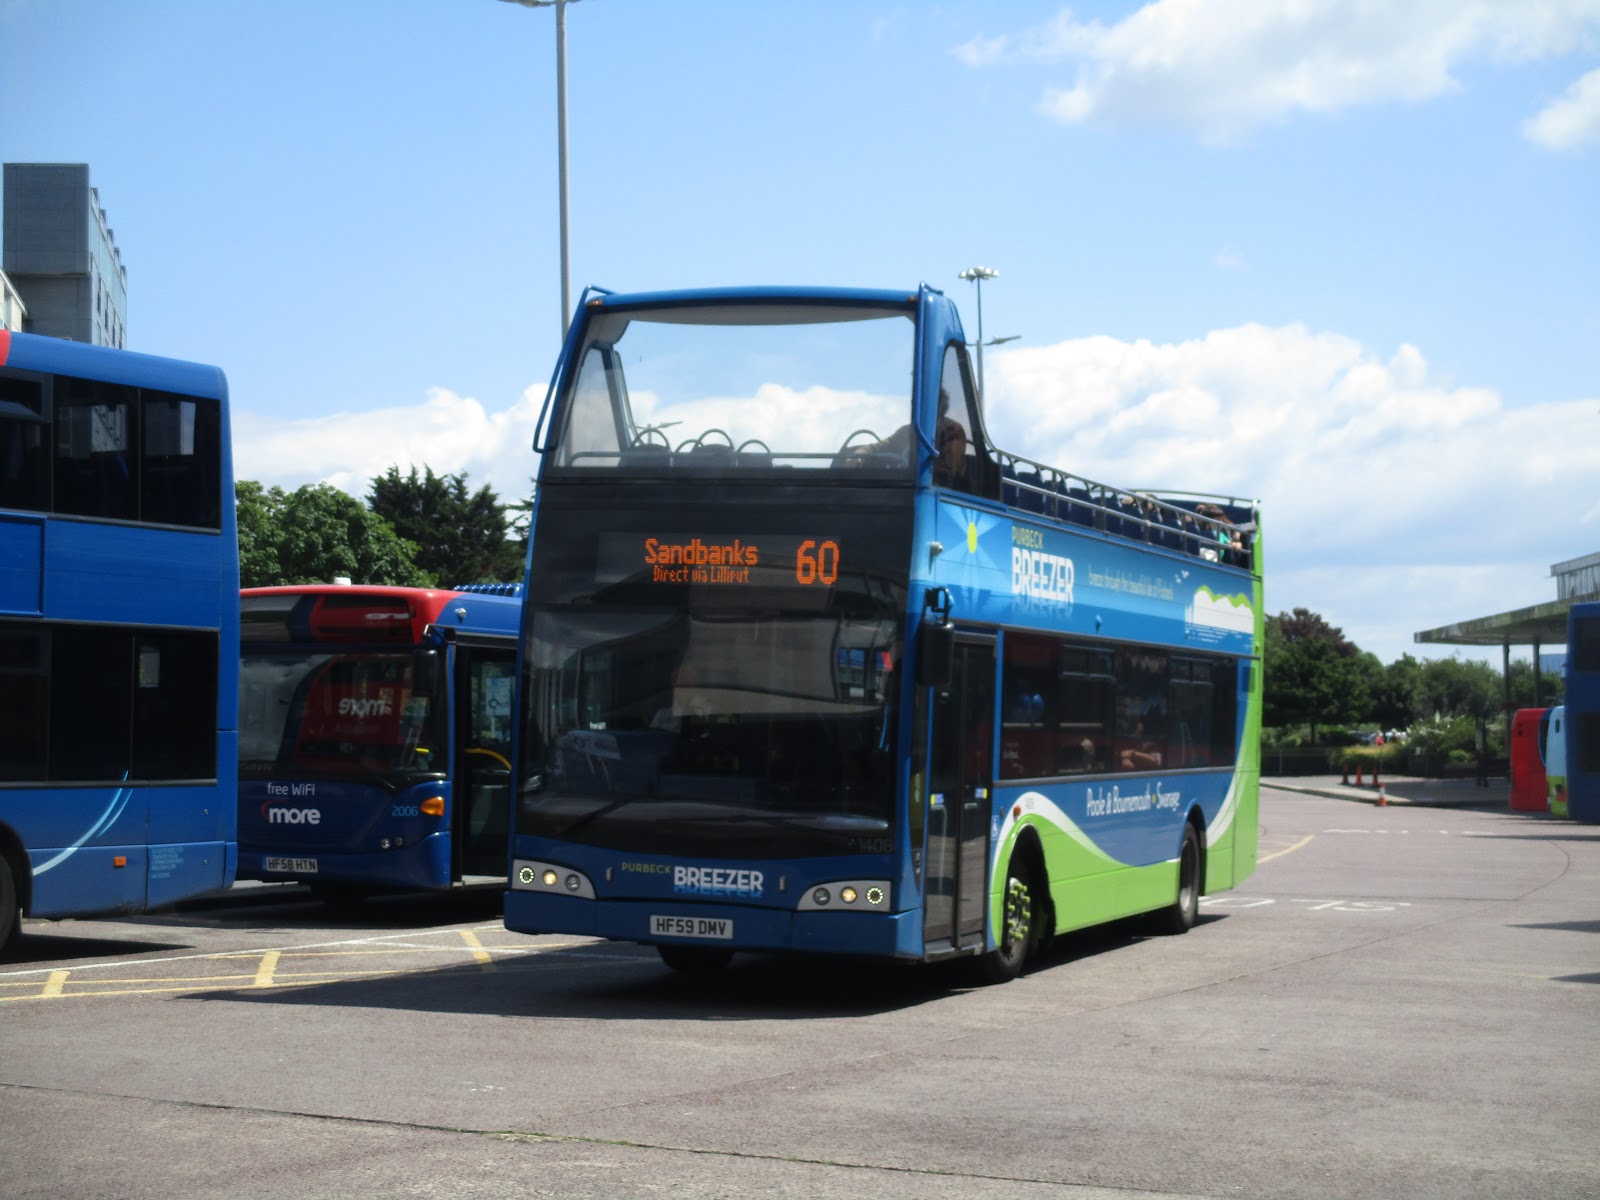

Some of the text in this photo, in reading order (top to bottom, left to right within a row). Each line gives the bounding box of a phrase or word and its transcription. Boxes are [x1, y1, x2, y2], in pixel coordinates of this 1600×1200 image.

[1012, 526, 1044, 549] PURBECK
[644, 537, 840, 585] Sandbanks 60
[653, 565, 689, 582] Direct
[691, 566, 708, 583] via
[1011, 547, 1075, 604] BREEZER
[267, 783, 316, 797] free WiFi
[268, 807, 321, 825] more
[392, 805, 419, 817] 2006
[268, 858, 316, 871] HF58 HTN
[621, 862, 764, 890] PURBECK BREEZER
[656, 917, 727, 936] HF59 DMV
